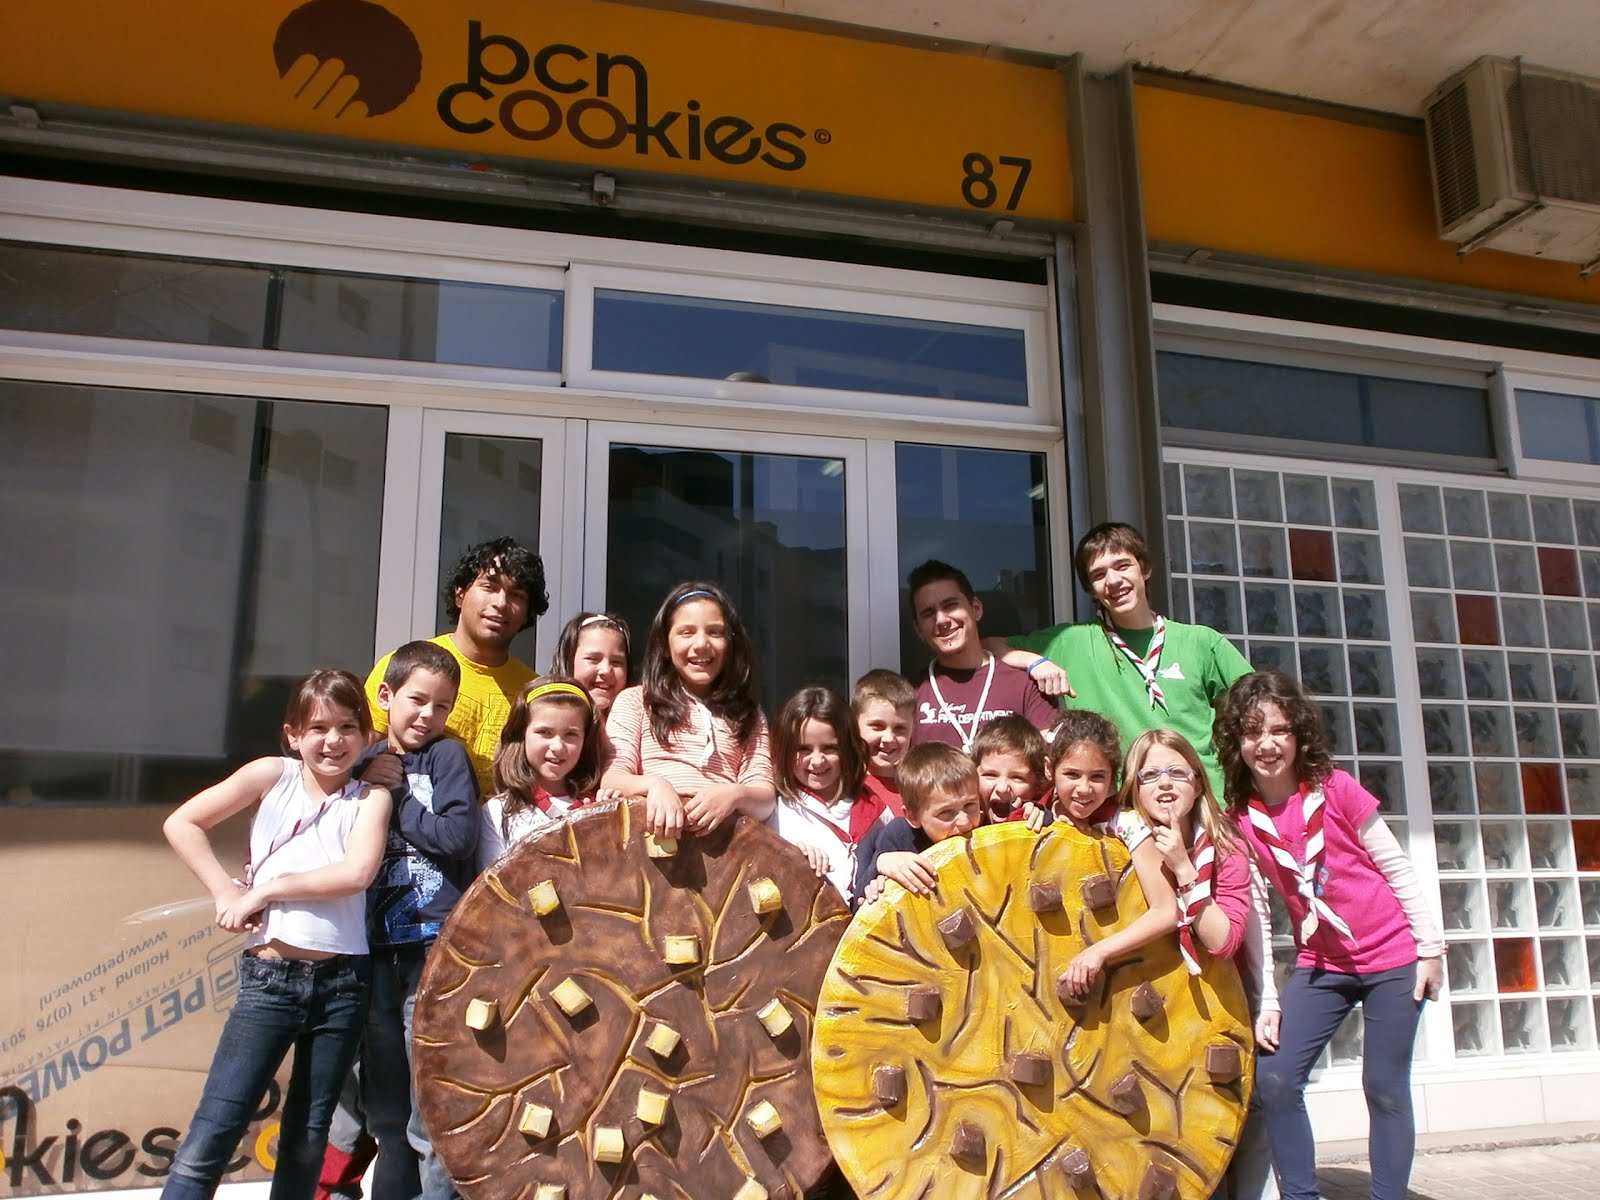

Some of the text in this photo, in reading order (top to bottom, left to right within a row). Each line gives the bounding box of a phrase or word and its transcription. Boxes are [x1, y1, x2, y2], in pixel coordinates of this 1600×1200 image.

[468, 20, 648, 98] bcn
[437, 82, 807, 171] cookies
[961, 152, 1032, 210] 87
[39, 930, 169, 1011] www.petpower.nl
[81, 985, 106, 1007] +31
[114, 949, 170, 989] Holland
[127, 967, 193, 1009] PARTNERS
[36, 1001, 72, 1031] (0)76
[140, 975, 206, 1043] PET
